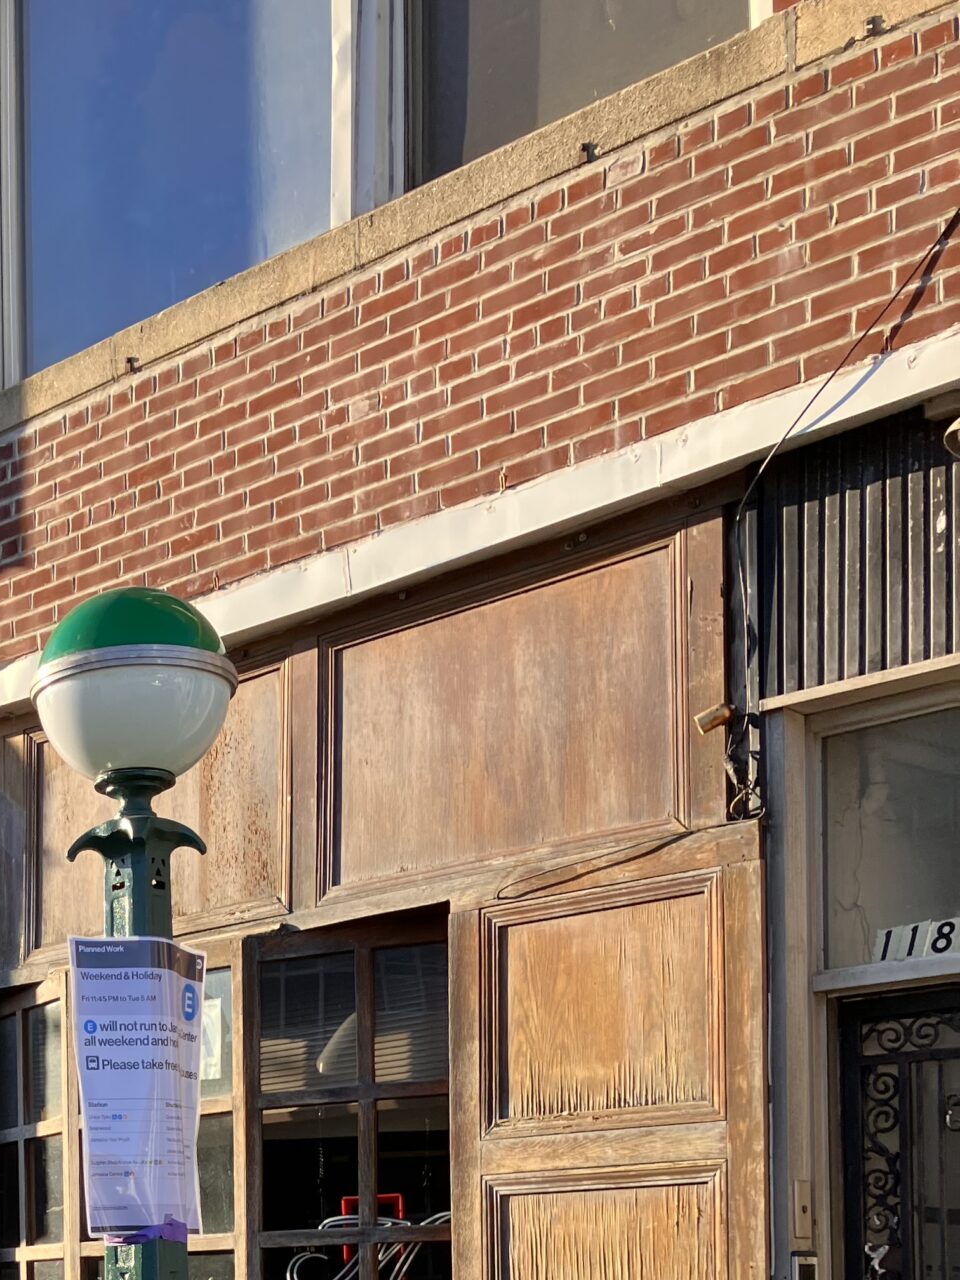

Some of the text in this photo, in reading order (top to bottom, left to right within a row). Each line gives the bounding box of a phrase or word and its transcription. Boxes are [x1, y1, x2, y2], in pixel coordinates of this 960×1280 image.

[879, 921, 956, 962] 118
[78, 945, 125, 953] Planned Work
[80, 971, 163, 982] Weekend & Holiday
[185, 991, 193, 1013] E
[99, 1021, 118, 1032] will
[119, 1022, 138, 1032] not
[139, 1023, 157, 1032] run
[158, 1022, 168, 1032] to
[84, 1036, 97, 1046] all
[97, 1036, 150, 1046] weekend
[150, 1036, 169, 1047] and
[102, 1059, 140, 1070] Please
[141, 1059, 164, 1070] take
